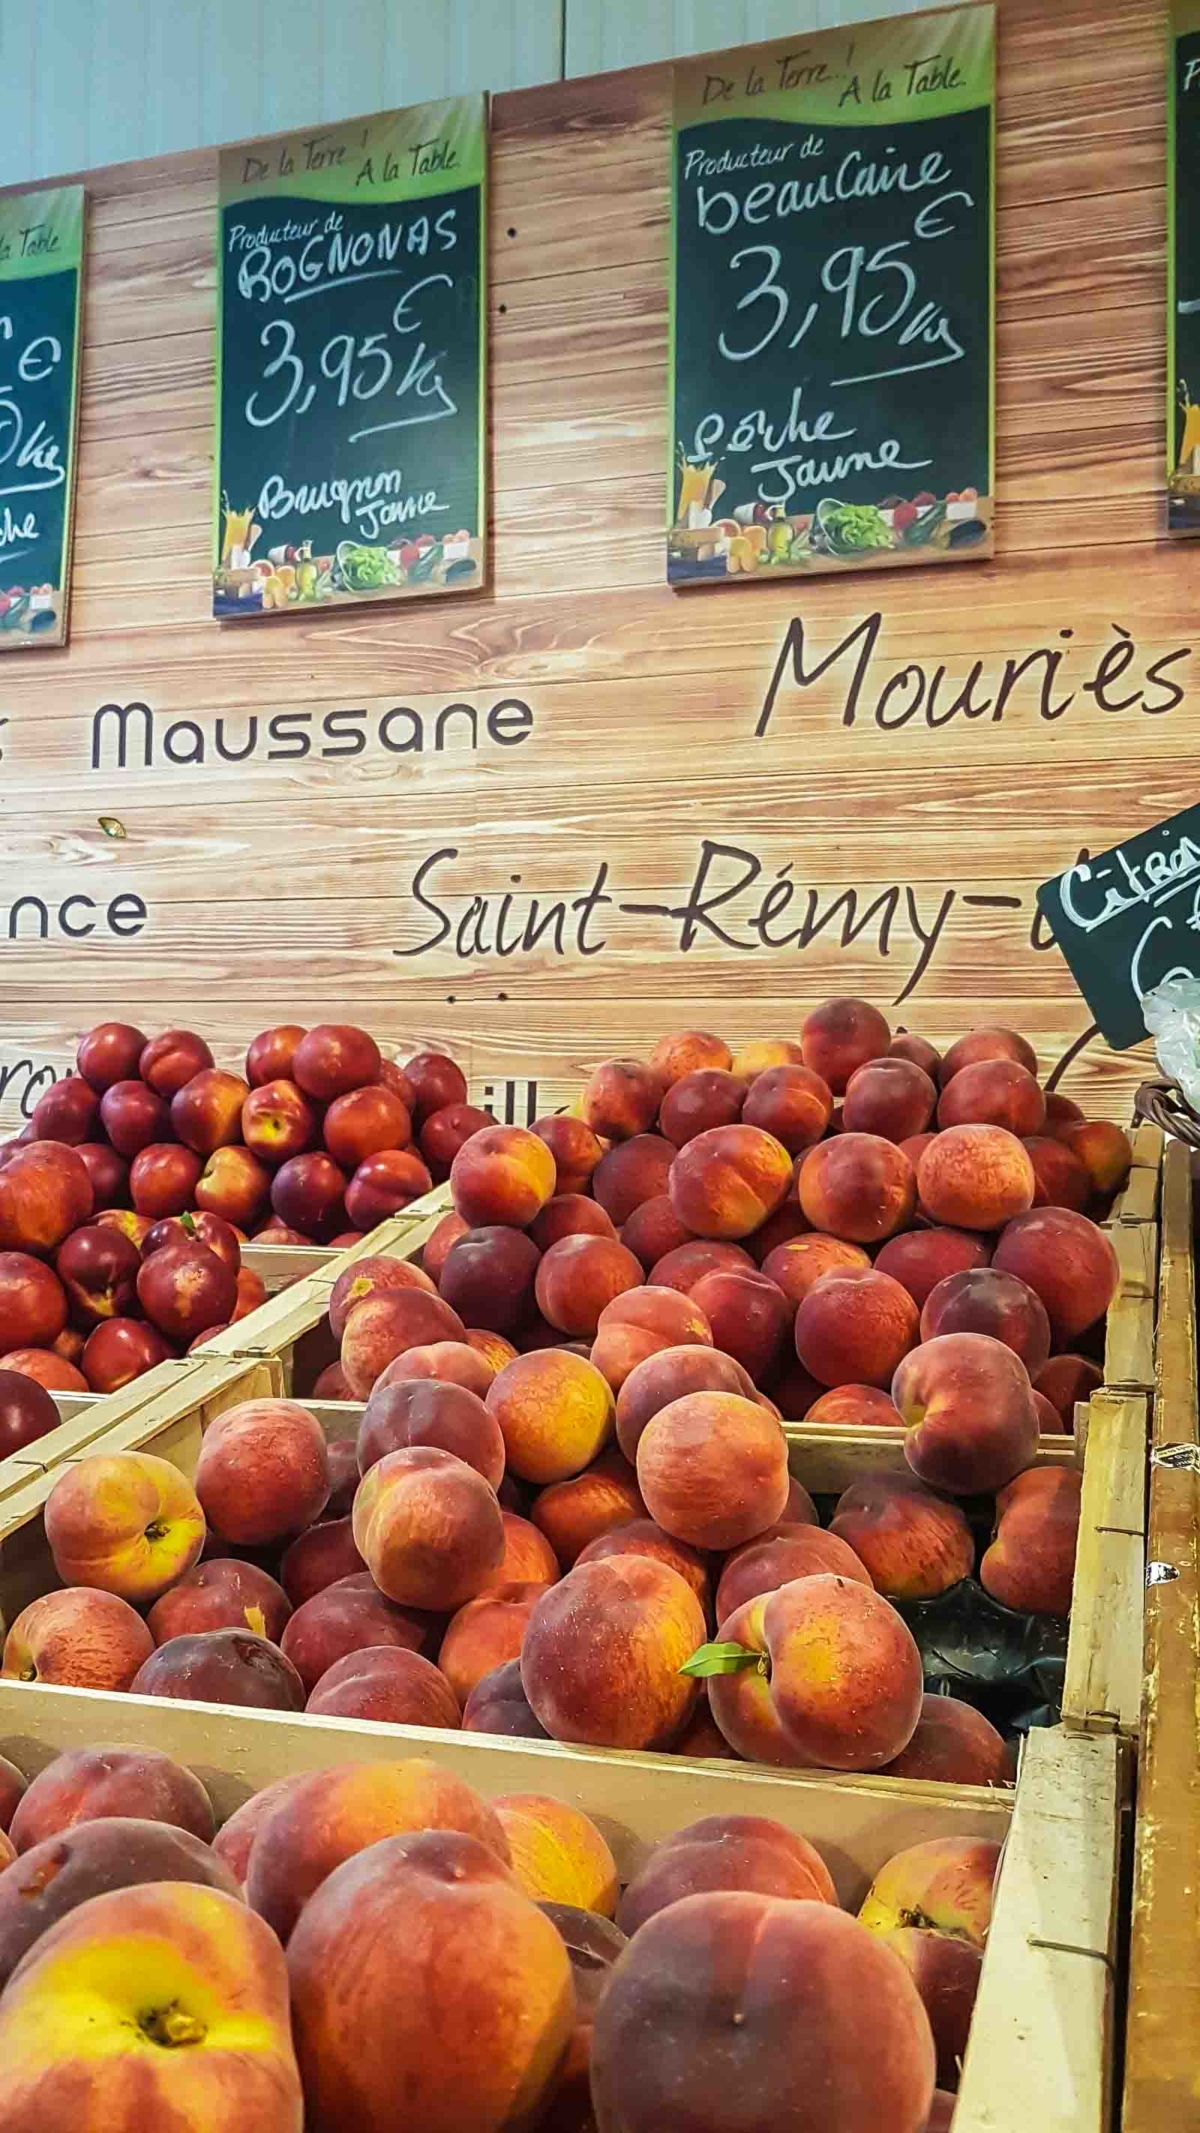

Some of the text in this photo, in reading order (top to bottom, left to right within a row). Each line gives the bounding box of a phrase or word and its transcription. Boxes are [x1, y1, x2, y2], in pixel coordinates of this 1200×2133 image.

[701, 75, 735, 105] De
[746, 67, 766, 96] la
[838, 76, 862, 108] A
[872, 68, 892, 102] la
[241, 157, 270, 185] De
[280, 149, 295, 176] la
[356, 157, 375, 186] A
[383, 154, 400, 181] la
[685, 133, 824, 180] Producteur de
[228, 211, 344, 252] Producteur de
[754, 612, 1192, 738] Mouriès
[91, 698, 535, 769] Maussane
[8, 892, 148, 939] nce
